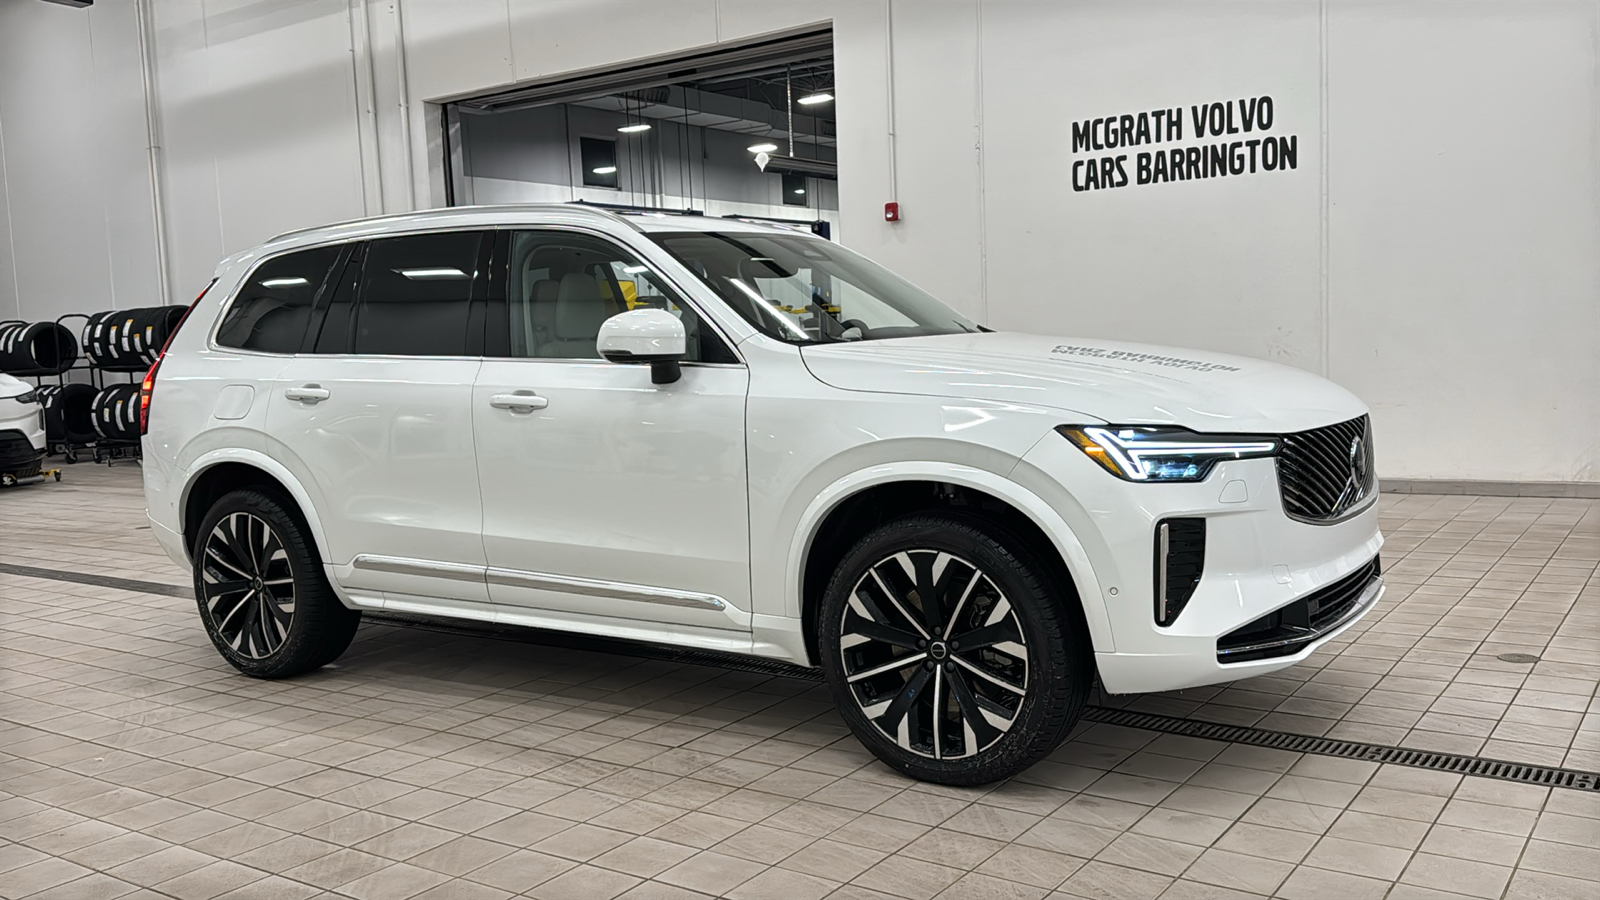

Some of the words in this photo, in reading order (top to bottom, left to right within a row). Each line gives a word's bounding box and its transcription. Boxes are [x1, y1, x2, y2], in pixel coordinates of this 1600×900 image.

[1072, 107, 1183, 153] MCGRATH
[1191, 95, 1273, 138] VOLVO
[1072, 154, 1129, 192] CARS
[1137, 135, 1298, 185] BARRINGTON
